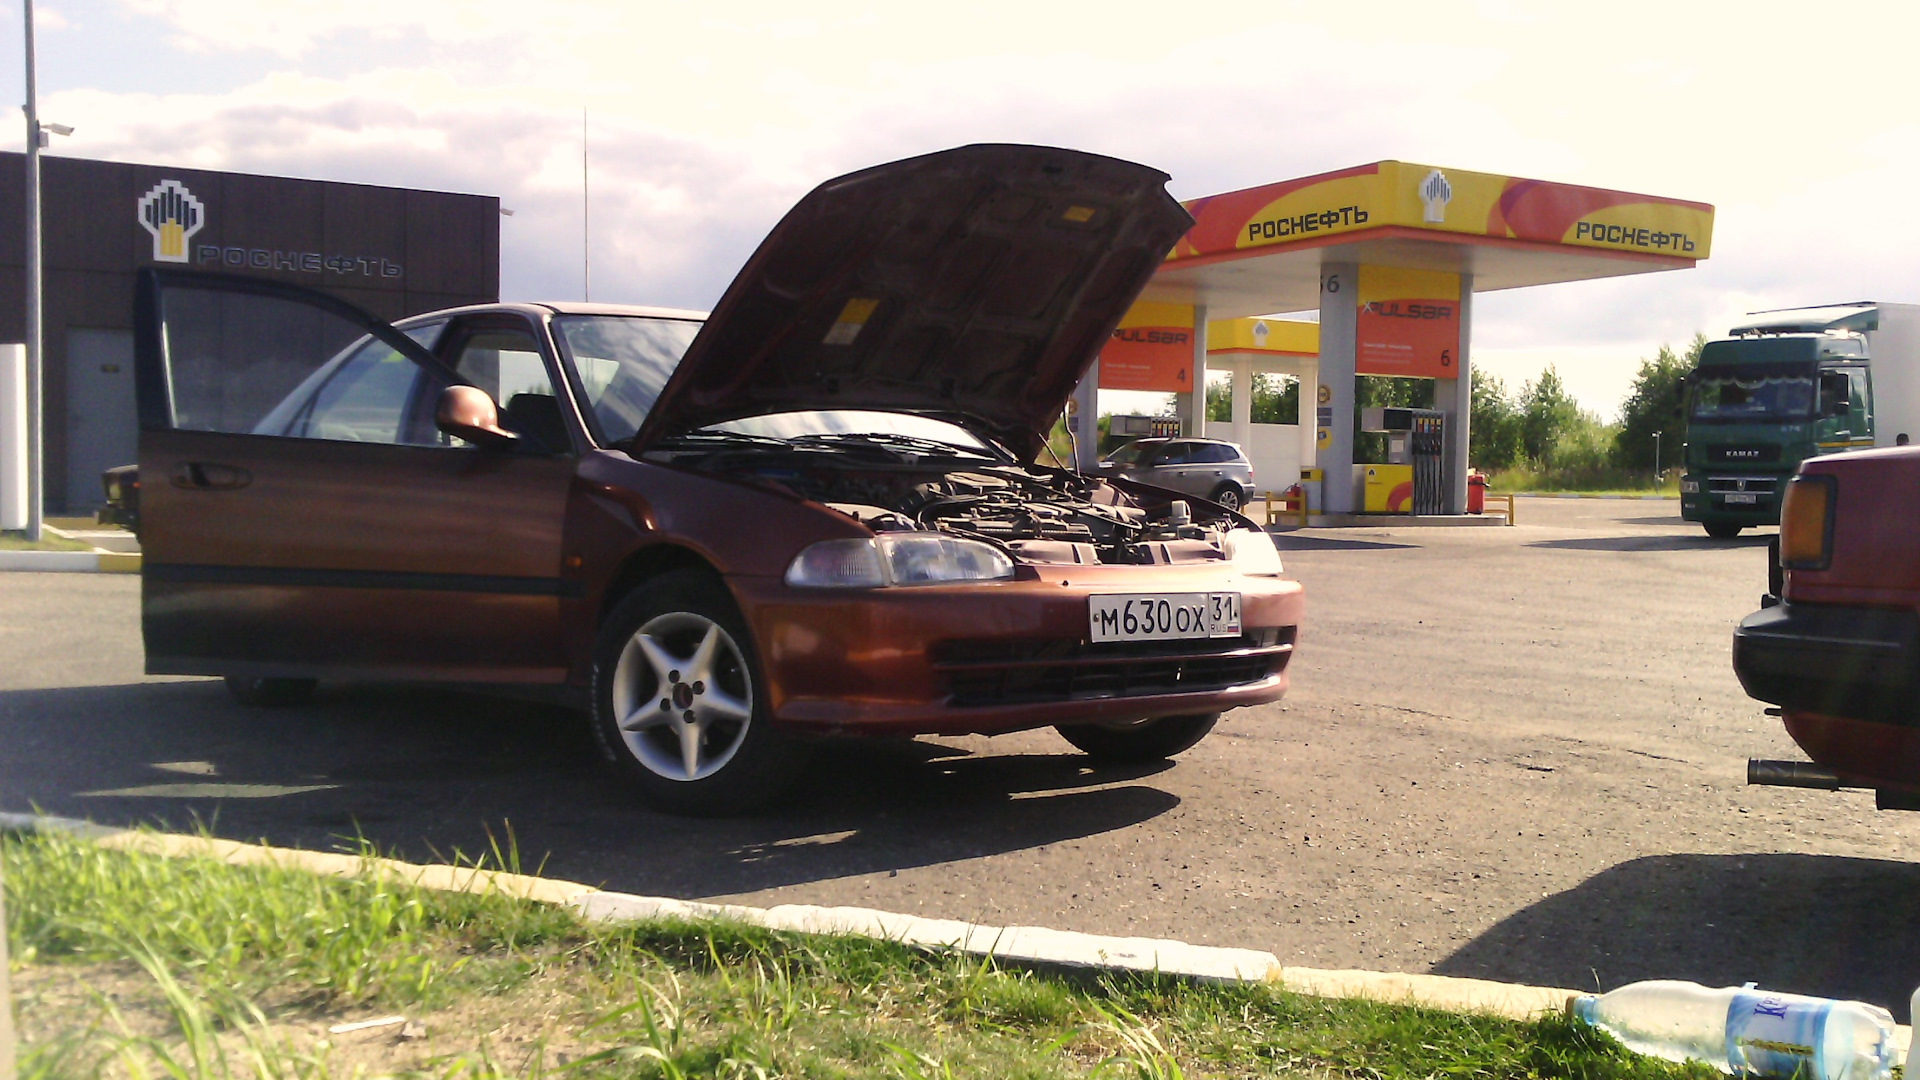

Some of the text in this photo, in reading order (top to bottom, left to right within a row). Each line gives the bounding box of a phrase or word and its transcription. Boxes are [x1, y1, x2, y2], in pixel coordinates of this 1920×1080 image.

[1249, 206, 1369, 241] РОСНЕФТЬ
[1576, 221, 1695, 252] РОСНЕФТЬ
[197, 245, 403, 278] РОСНЕФТЬ
[1320, 274, 1340, 293] 6
[1440, 349, 1451, 367] 6
[1177, 368, 1187, 383] 4
[1100, 596, 1233, 636] М630ОХ 31
[1210, 623, 1227, 633] RUS
